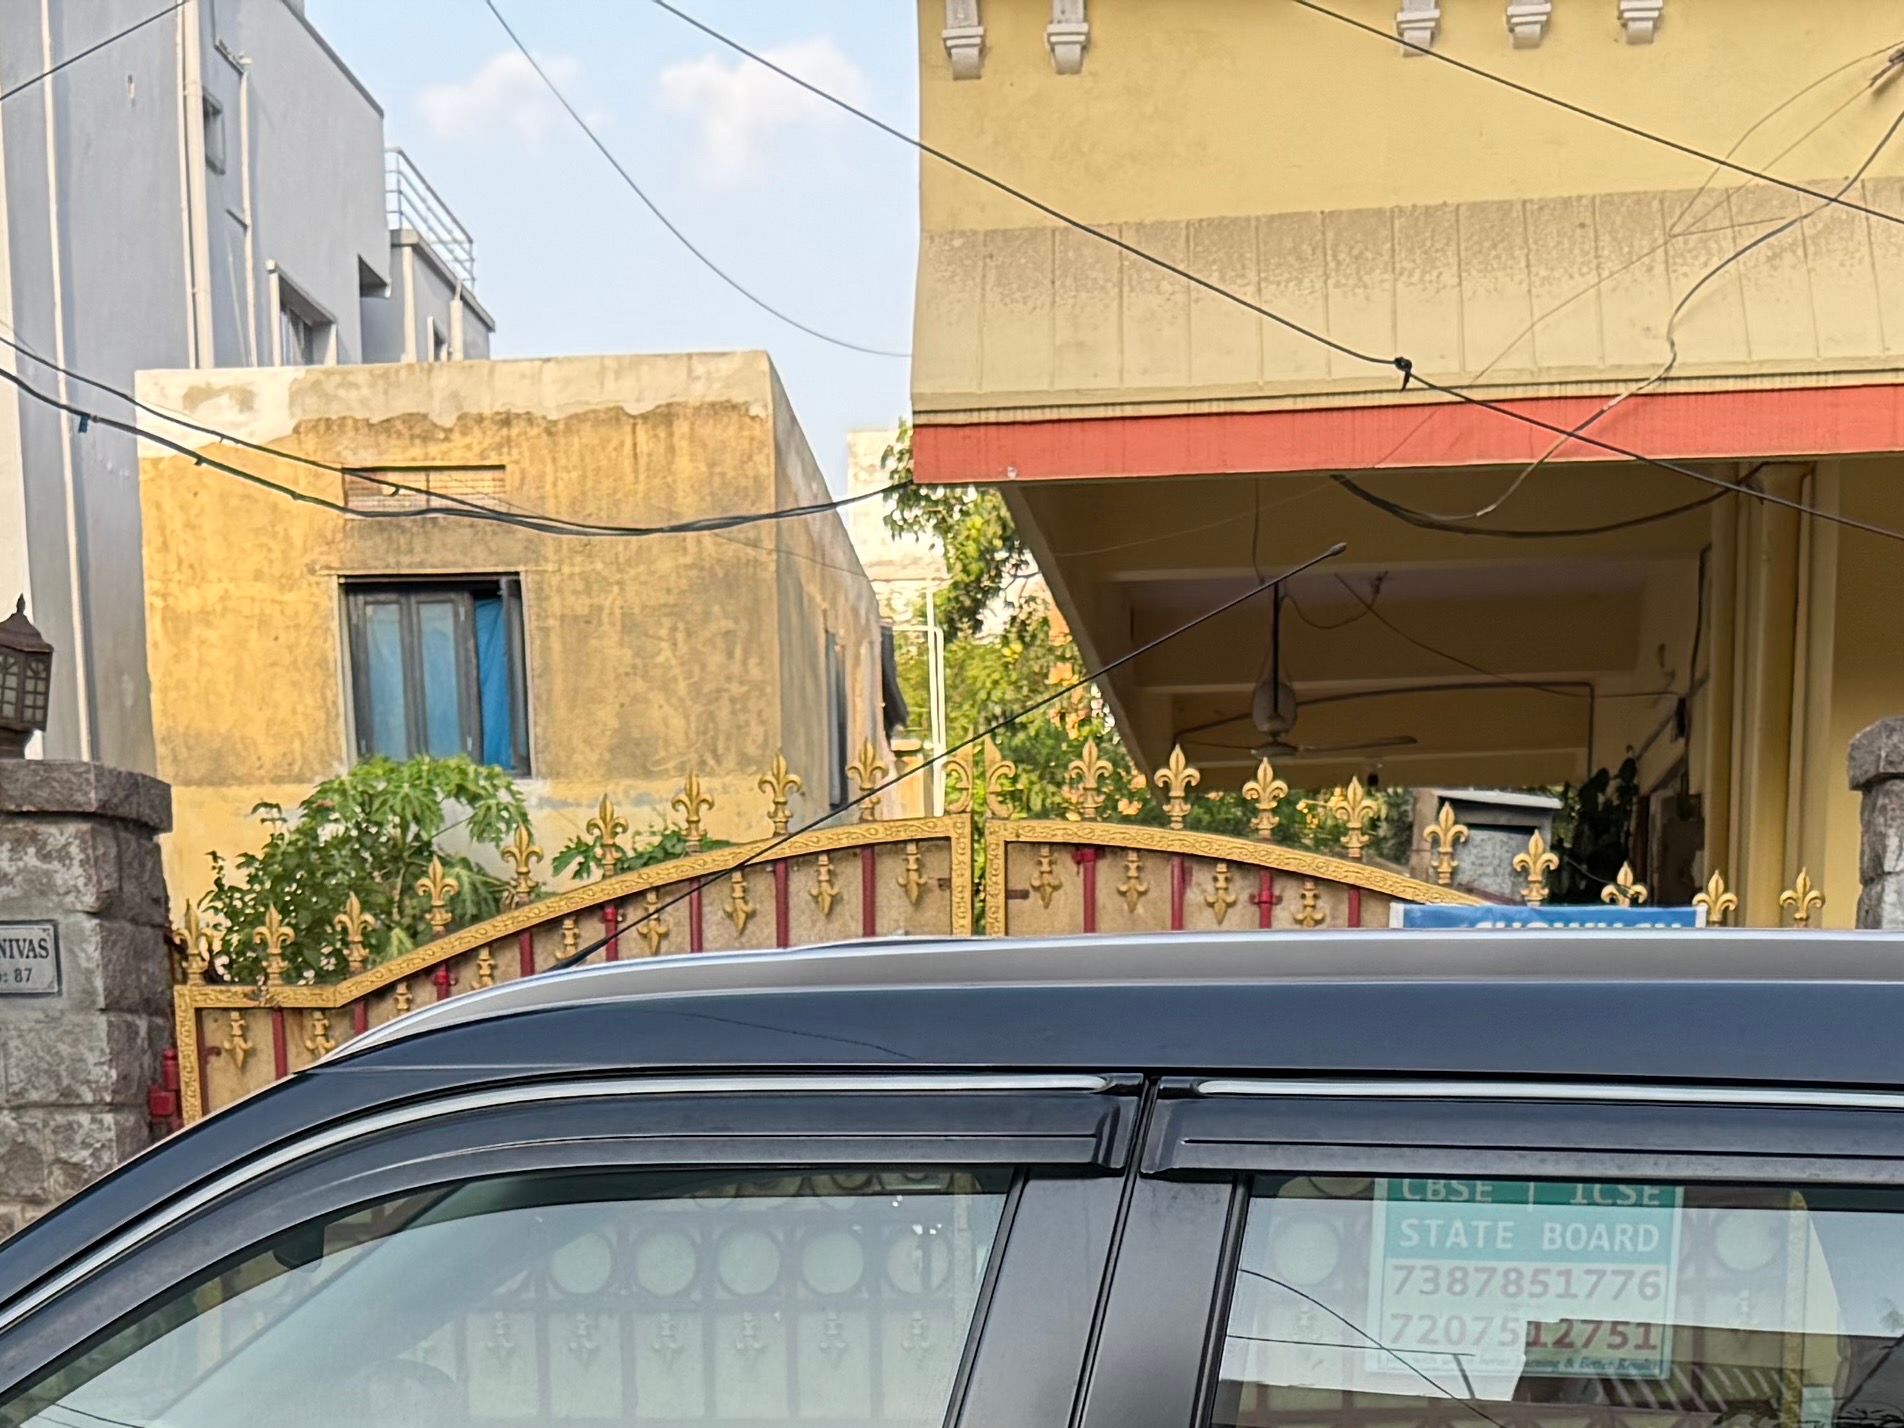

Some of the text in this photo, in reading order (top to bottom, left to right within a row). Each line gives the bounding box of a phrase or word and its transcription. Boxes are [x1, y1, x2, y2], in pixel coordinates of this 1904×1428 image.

[13, 967, 33, 983] 87
[1401, 1179, 1494, 1202] CBSE
[1569, 1184, 1661, 1206] ICSE
[1398, 1217, 1661, 1253] STATE BOARD
[1390, 1263, 1662, 1302] 7387851776
[1389, 1312, 1659, 1351] 7207512751
